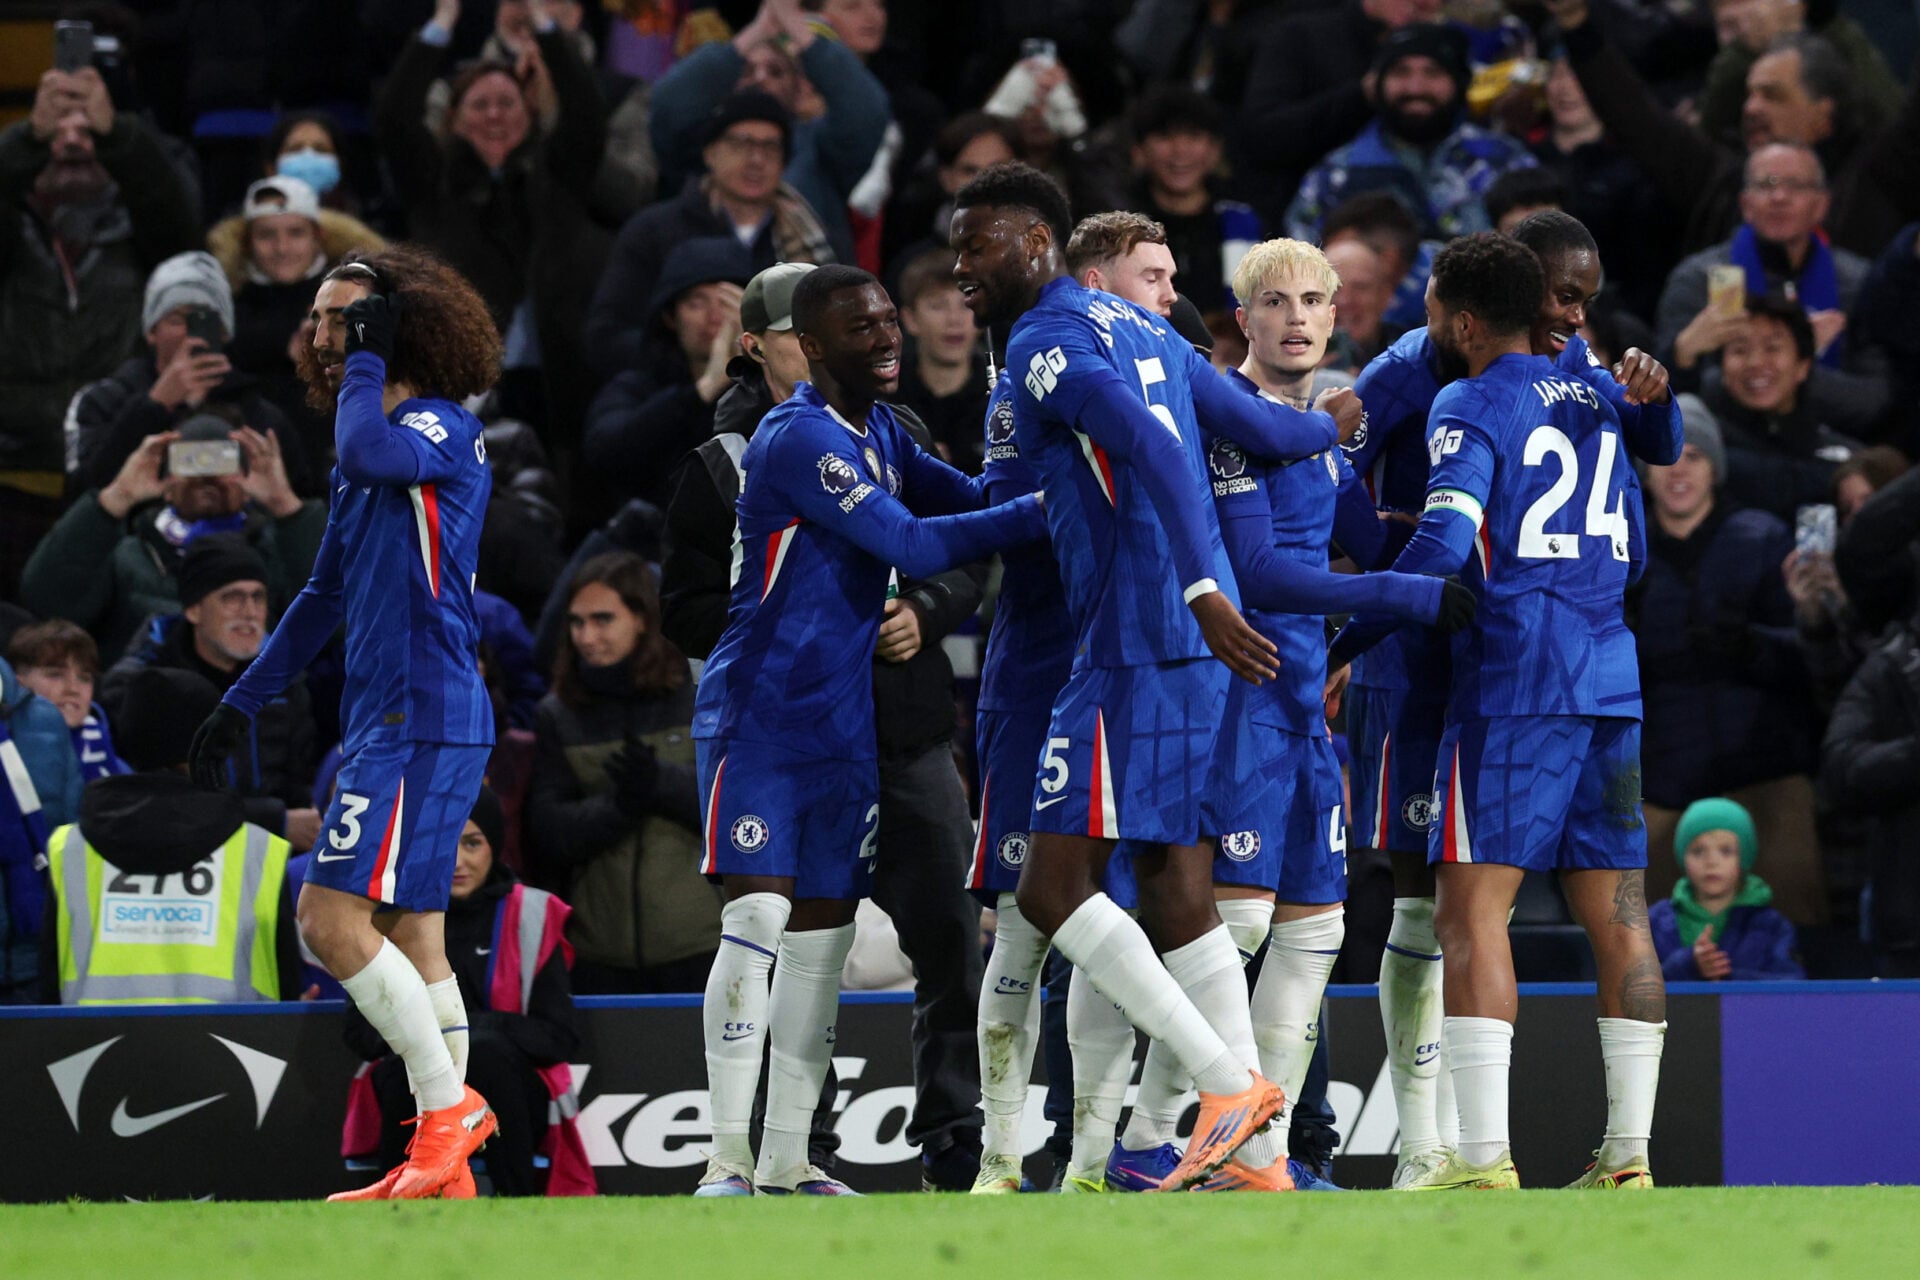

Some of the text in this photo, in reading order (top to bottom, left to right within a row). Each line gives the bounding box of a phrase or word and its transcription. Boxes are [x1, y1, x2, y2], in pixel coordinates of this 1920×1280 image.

[1027, 349, 1063, 398] FPT
[1134, 357, 1182, 444] 5
[1532, 380, 1598, 410] JAMES
[1429, 431, 1461, 459] PT
[1428, 493, 1453, 505] tain
[1517, 425, 1630, 562] 24
[1041, 737, 1070, 793] 5
[328, 793, 370, 850] 3
[115, 906, 202, 922] servoca
[999, 976, 1030, 990] CFC
[724, 1022, 755, 1031] CFC
